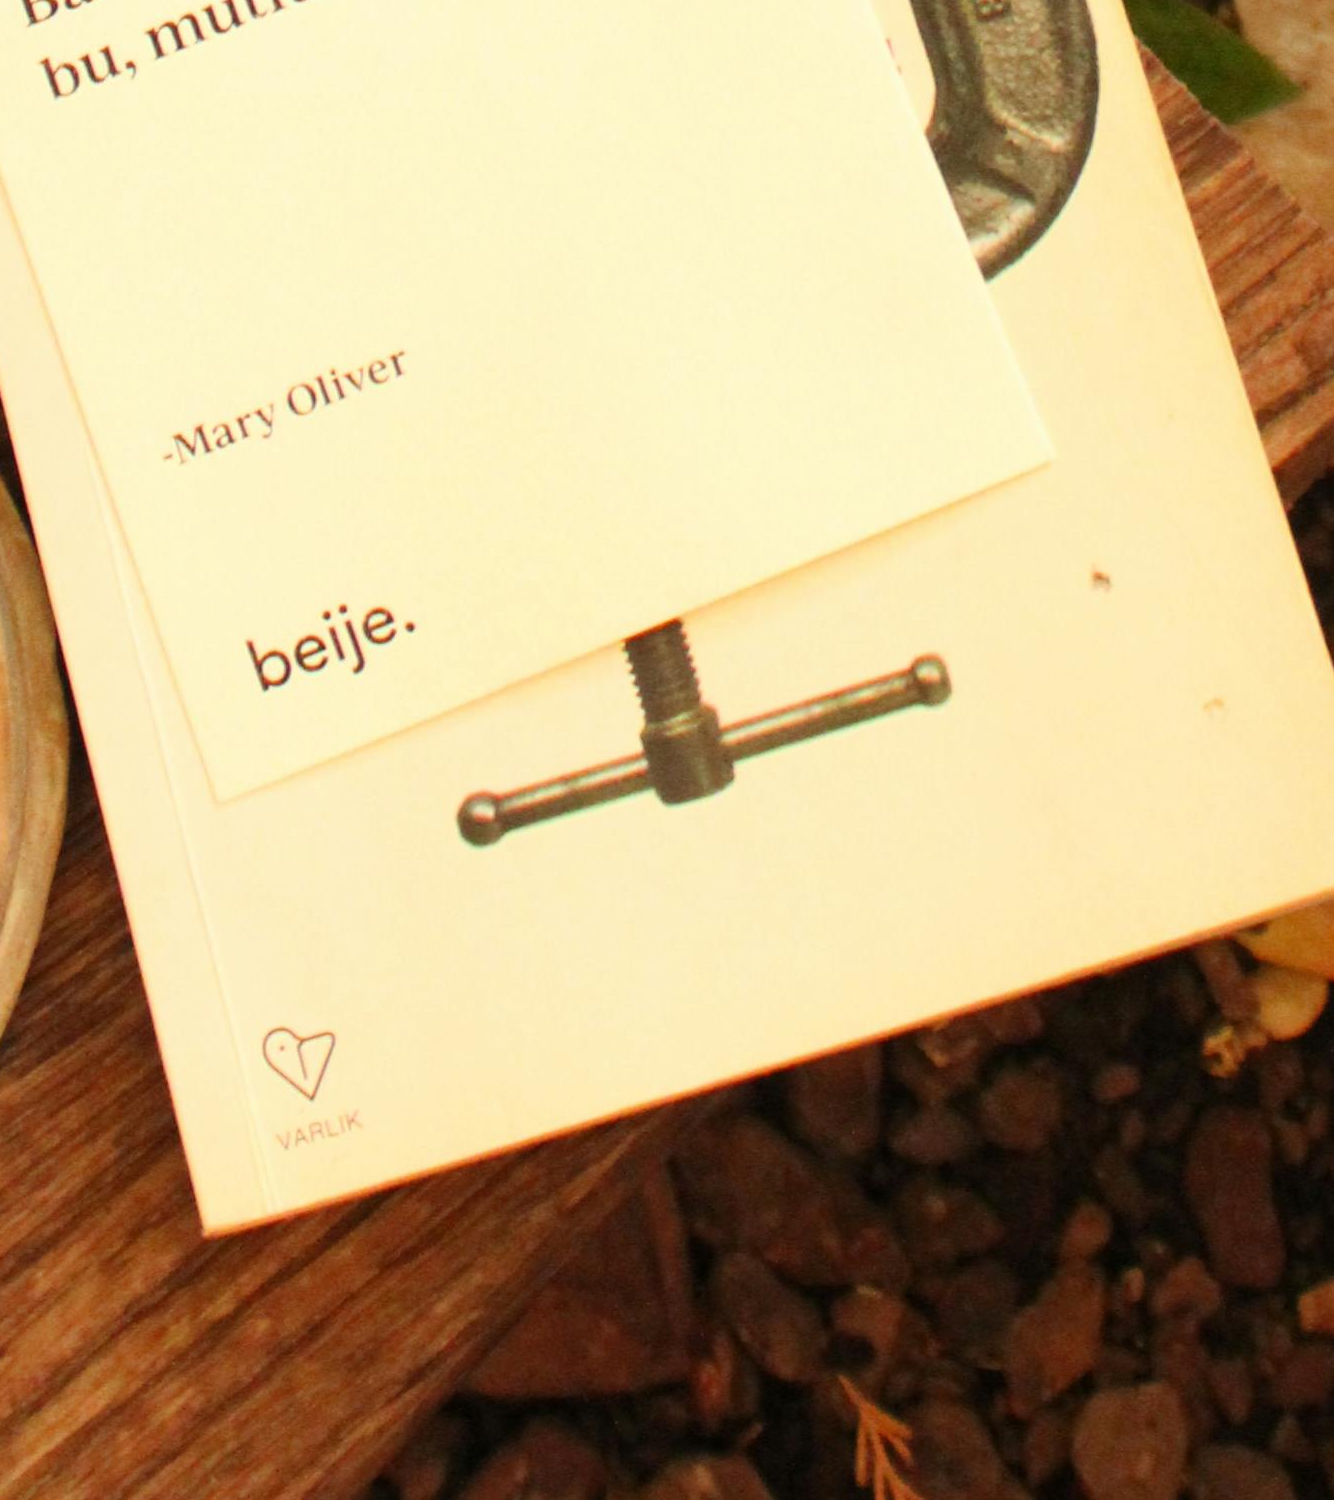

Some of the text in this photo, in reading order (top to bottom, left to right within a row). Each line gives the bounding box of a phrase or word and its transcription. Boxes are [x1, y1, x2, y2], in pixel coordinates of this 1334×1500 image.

[40, 45, 138, 99] bu,
[163, 350, 407, 464] -Mary Oliver
[245, 603, 417, 692] beije.
[275, 1108, 364, 1150] VARLIK
